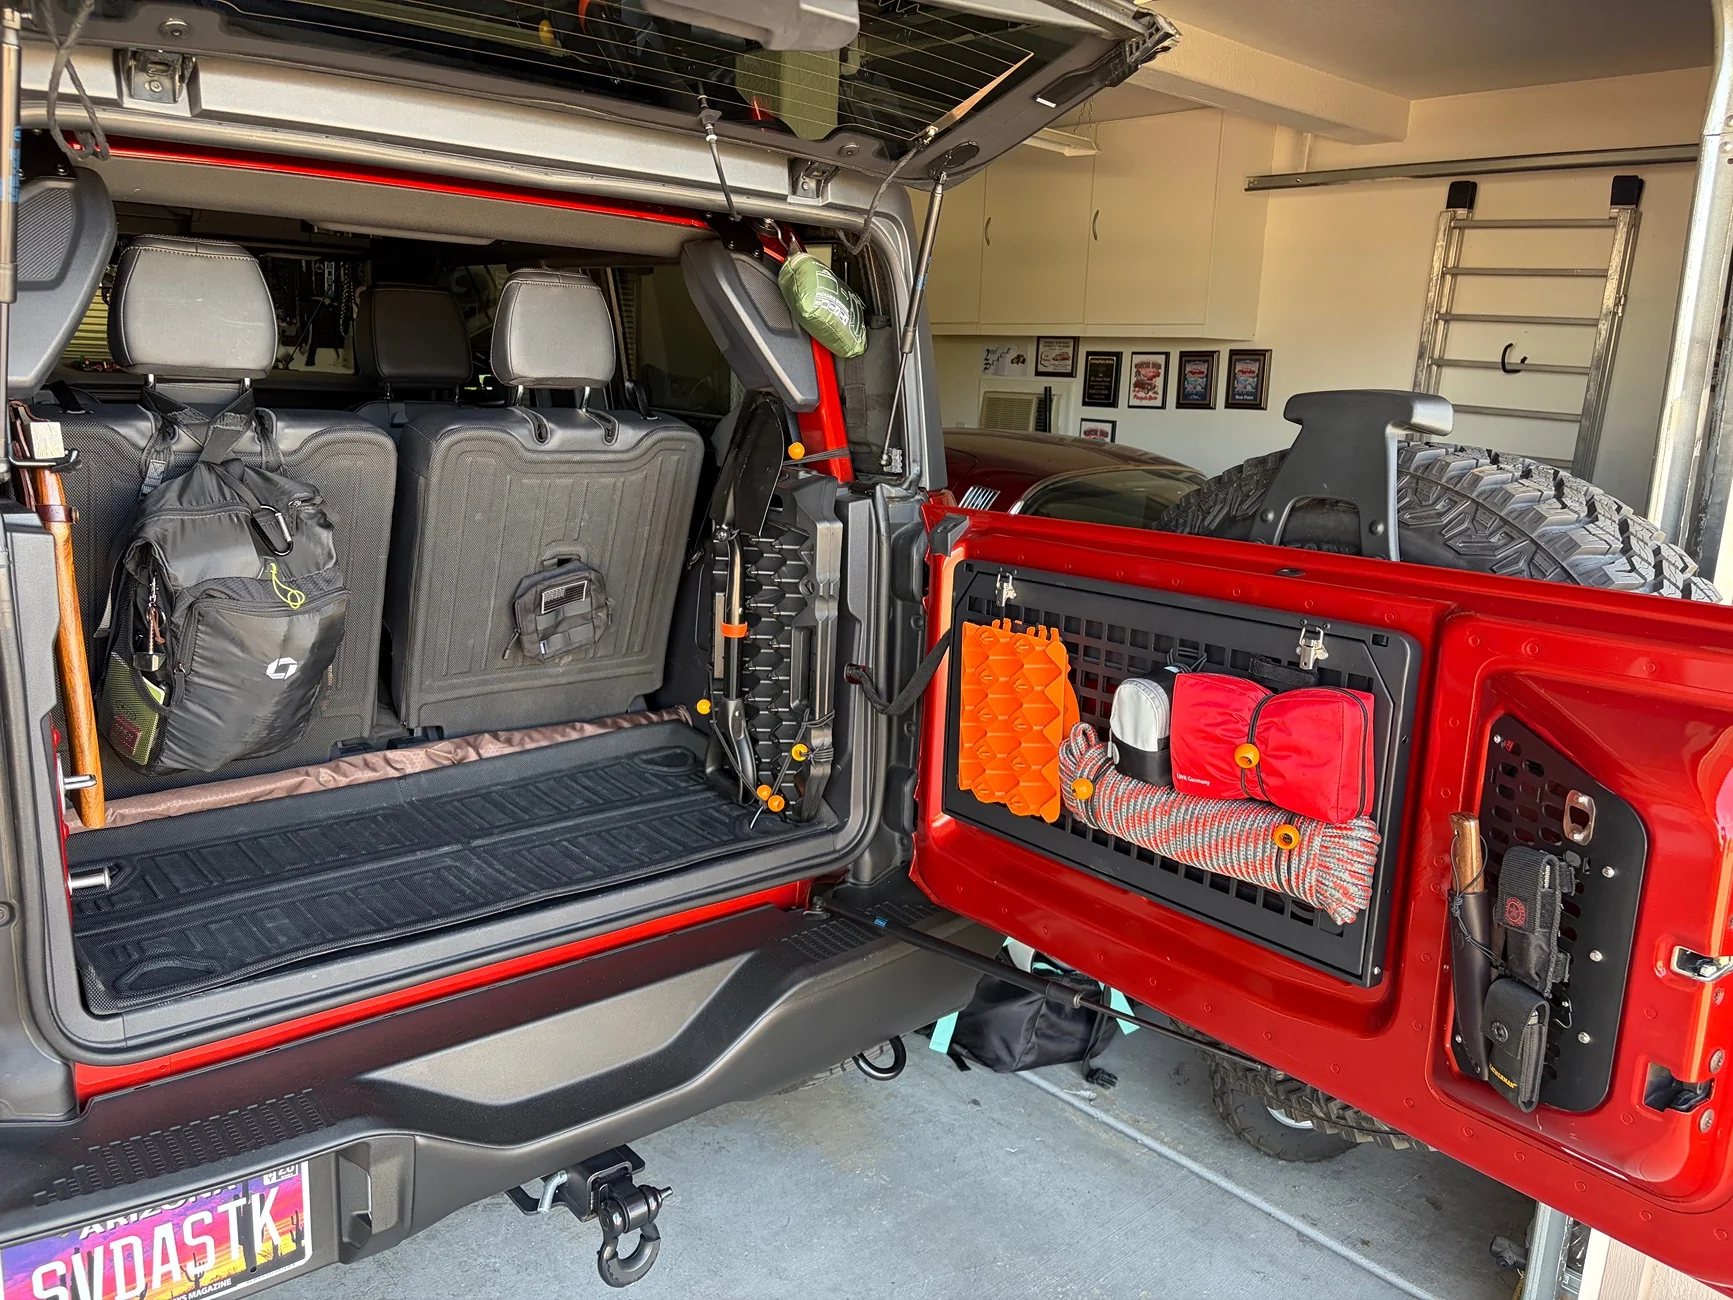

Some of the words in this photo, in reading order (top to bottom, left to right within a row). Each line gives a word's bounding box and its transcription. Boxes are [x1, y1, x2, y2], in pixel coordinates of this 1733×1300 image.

[79, 1184, 237, 1240] ARIZO
[32, 1186, 282, 1300] SVDASTK
[188, 1278, 232, 1300] MAGAZINE
